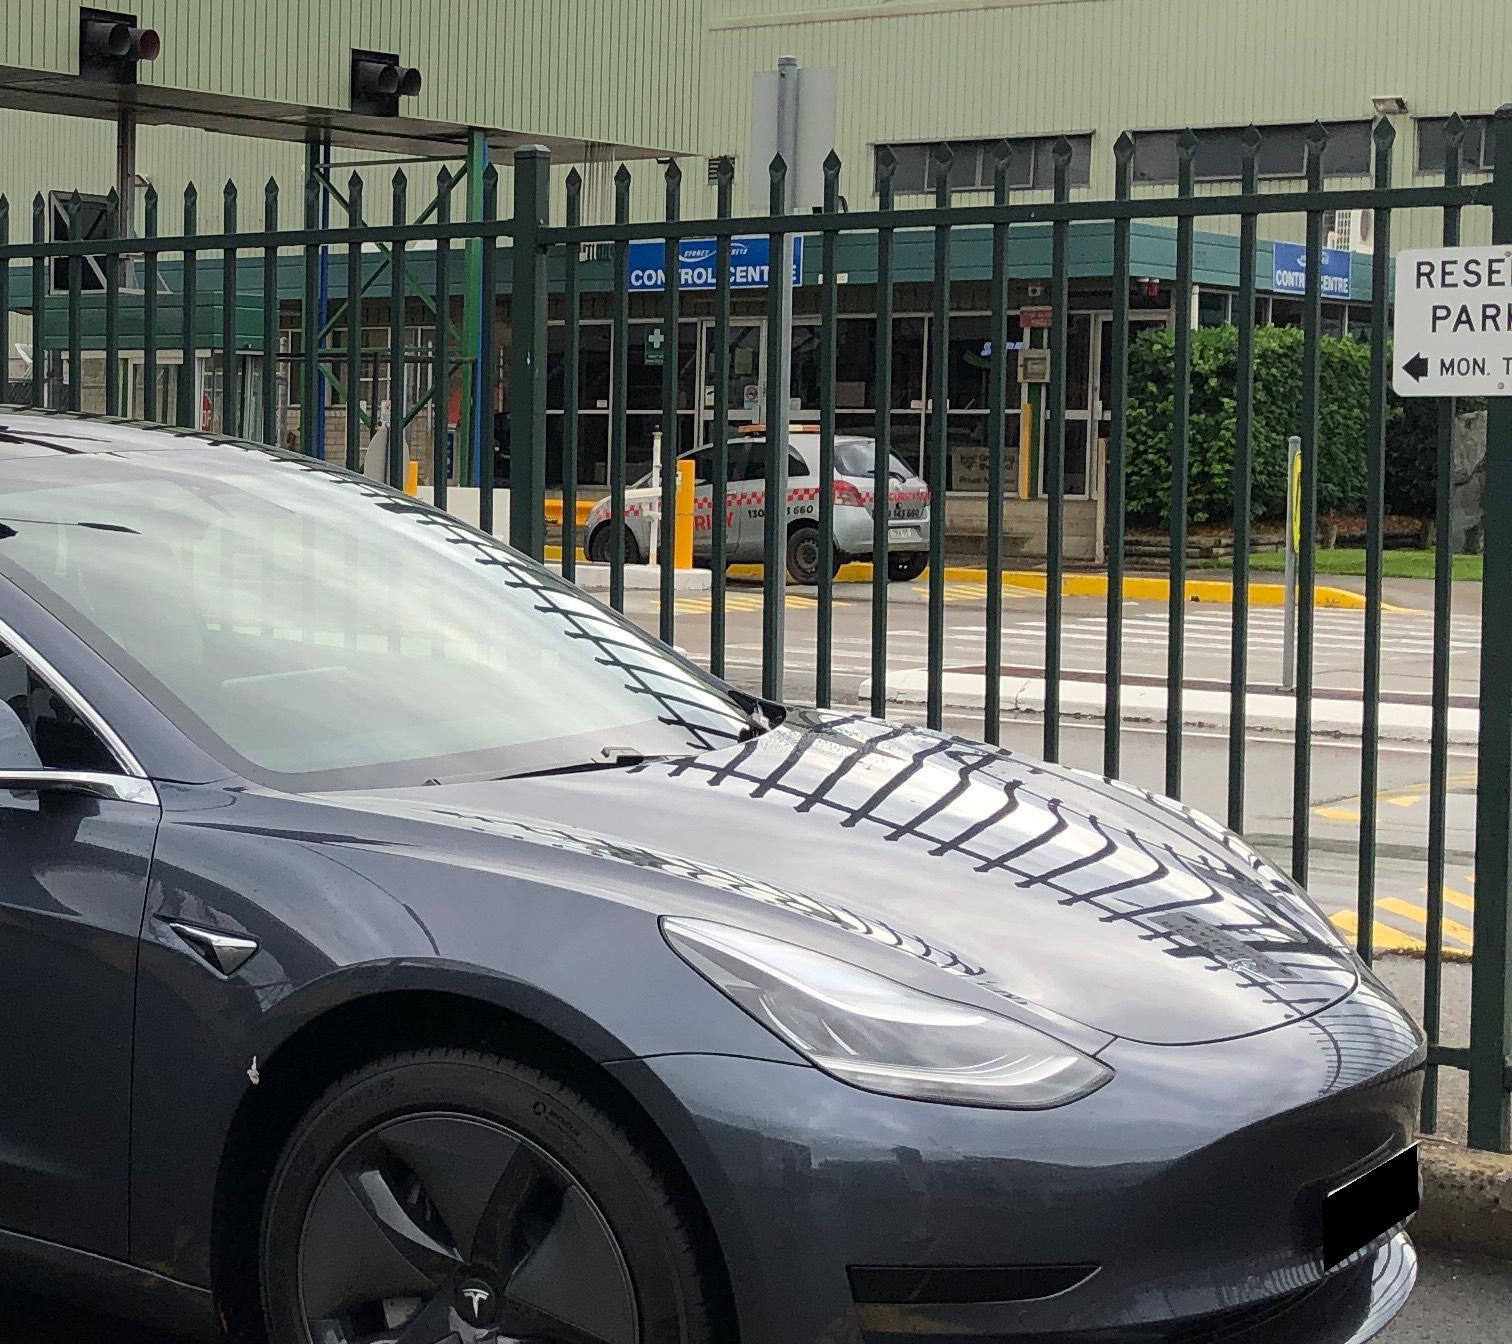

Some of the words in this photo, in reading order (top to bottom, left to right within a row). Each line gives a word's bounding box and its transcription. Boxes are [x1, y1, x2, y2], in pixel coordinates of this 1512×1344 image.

[630, 267, 717, 287] CONROL
[1416, 258, 1512, 289] RESE
[1440, 357, 1491, 377] MON.
